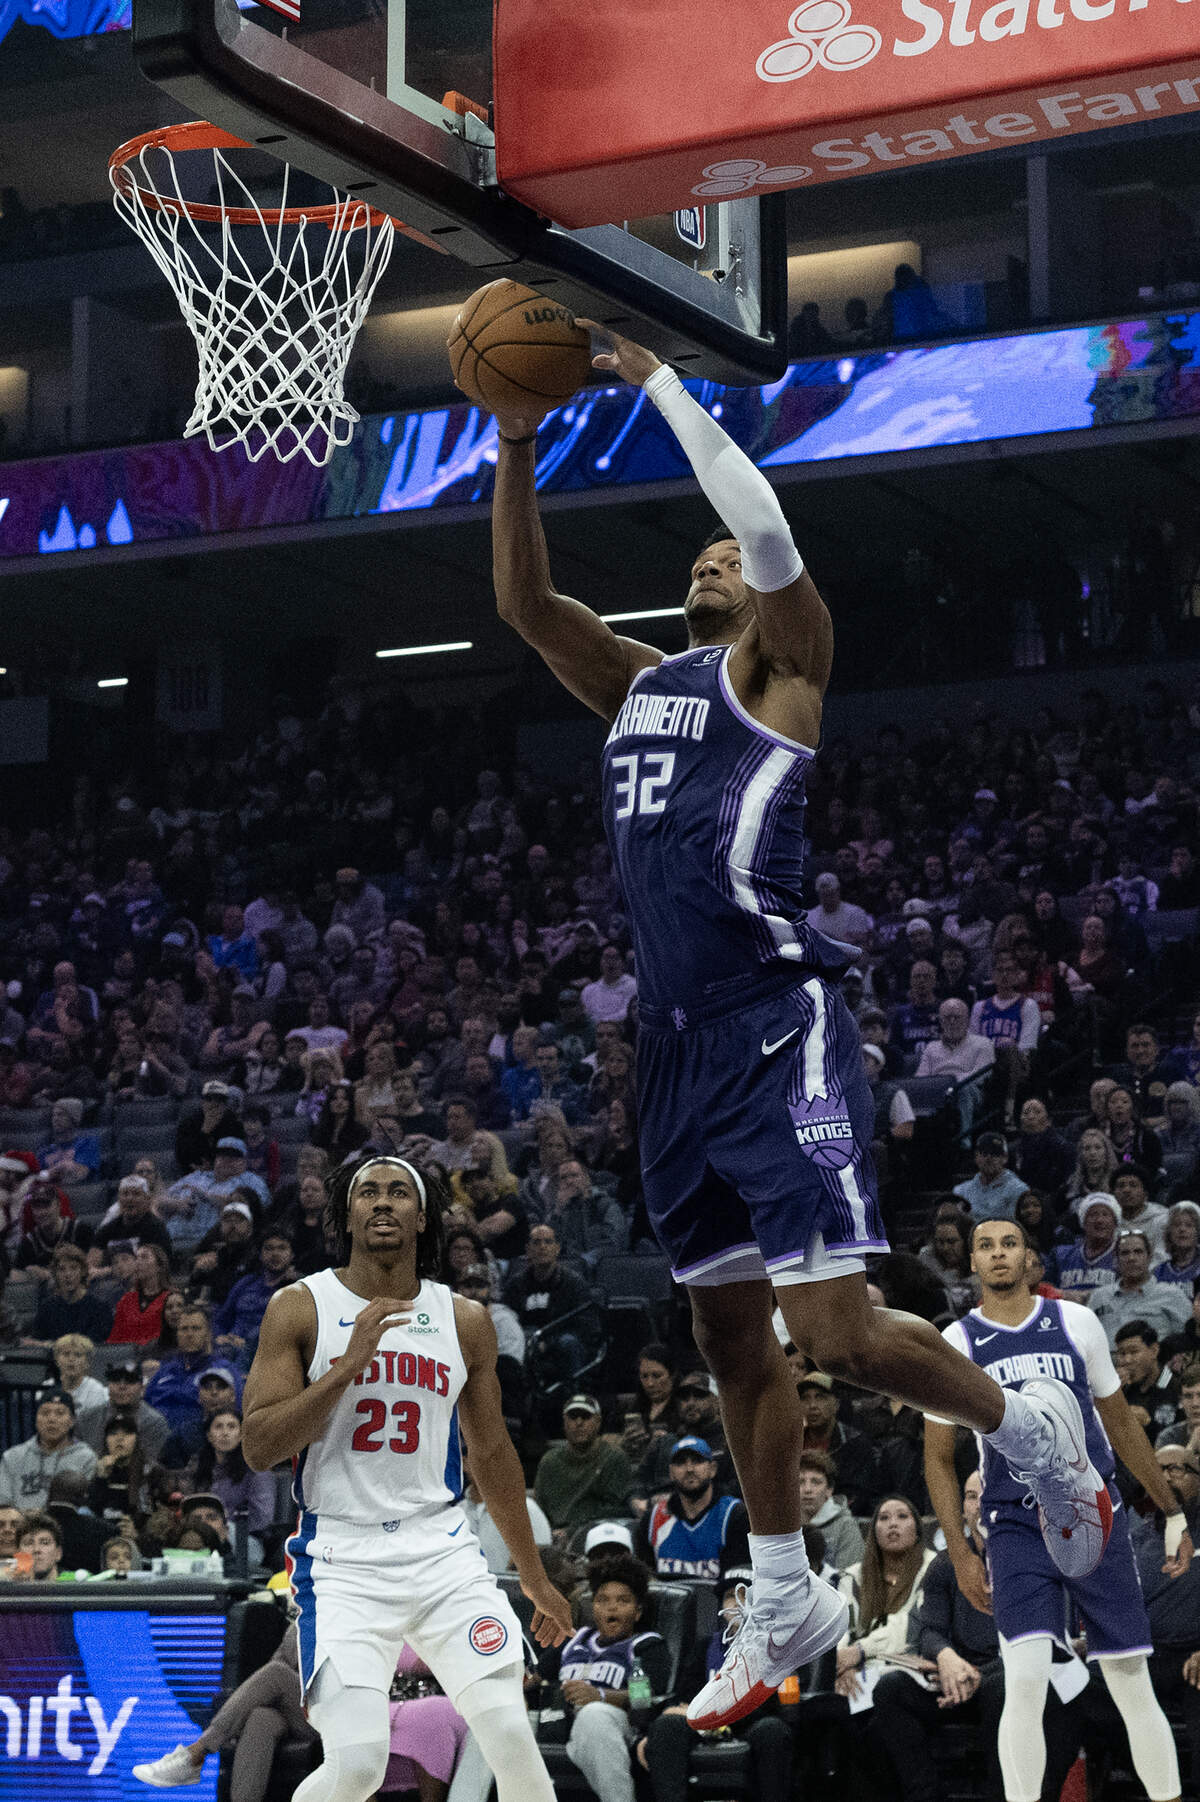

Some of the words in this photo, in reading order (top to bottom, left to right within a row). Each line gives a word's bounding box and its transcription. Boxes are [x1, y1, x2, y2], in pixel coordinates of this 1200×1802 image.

[612, 753, 676, 818] 32
[795, 1122, 853, 1145] KINGS
[407, 1325, 440, 1334] StockX
[329, 1350, 451, 1397] STONS
[351, 1398, 421, 1454] 23
